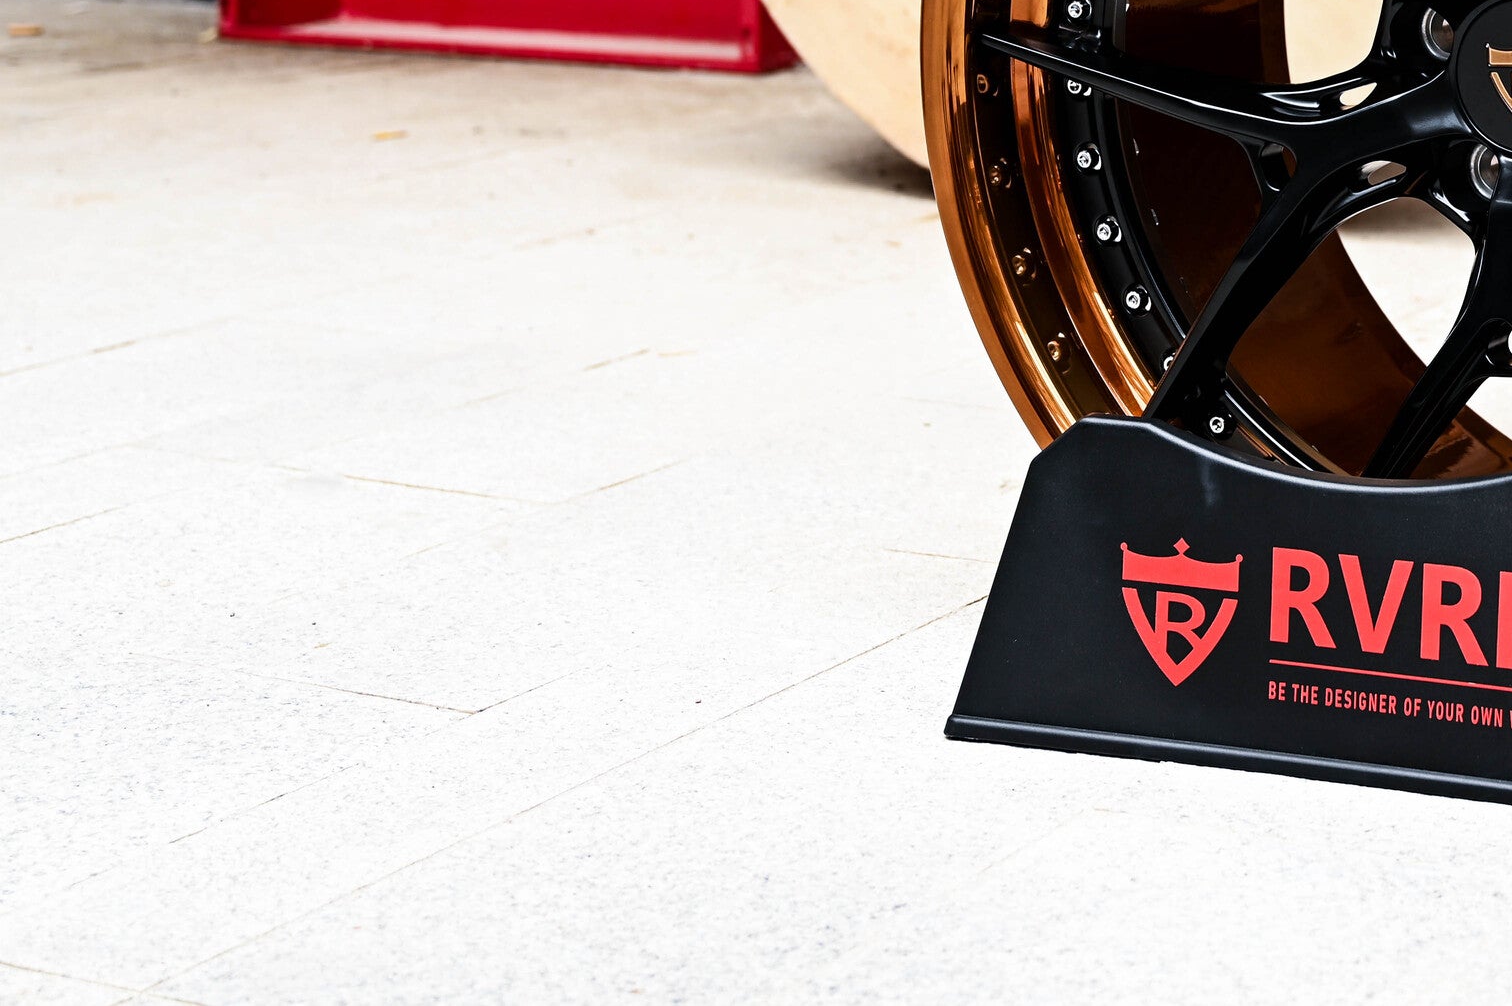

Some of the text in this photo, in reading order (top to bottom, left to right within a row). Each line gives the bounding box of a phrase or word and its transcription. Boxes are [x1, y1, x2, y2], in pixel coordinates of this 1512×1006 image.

[1268, 680, 1287, 702] BE
[1291, 683, 1319, 706] THE
[1324, 687, 1397, 715] DESIGNER
[1403, 696, 1422, 718] OF
[1427, 699, 1465, 723] YOUR
[1470, 705, 1504, 728] OWN
